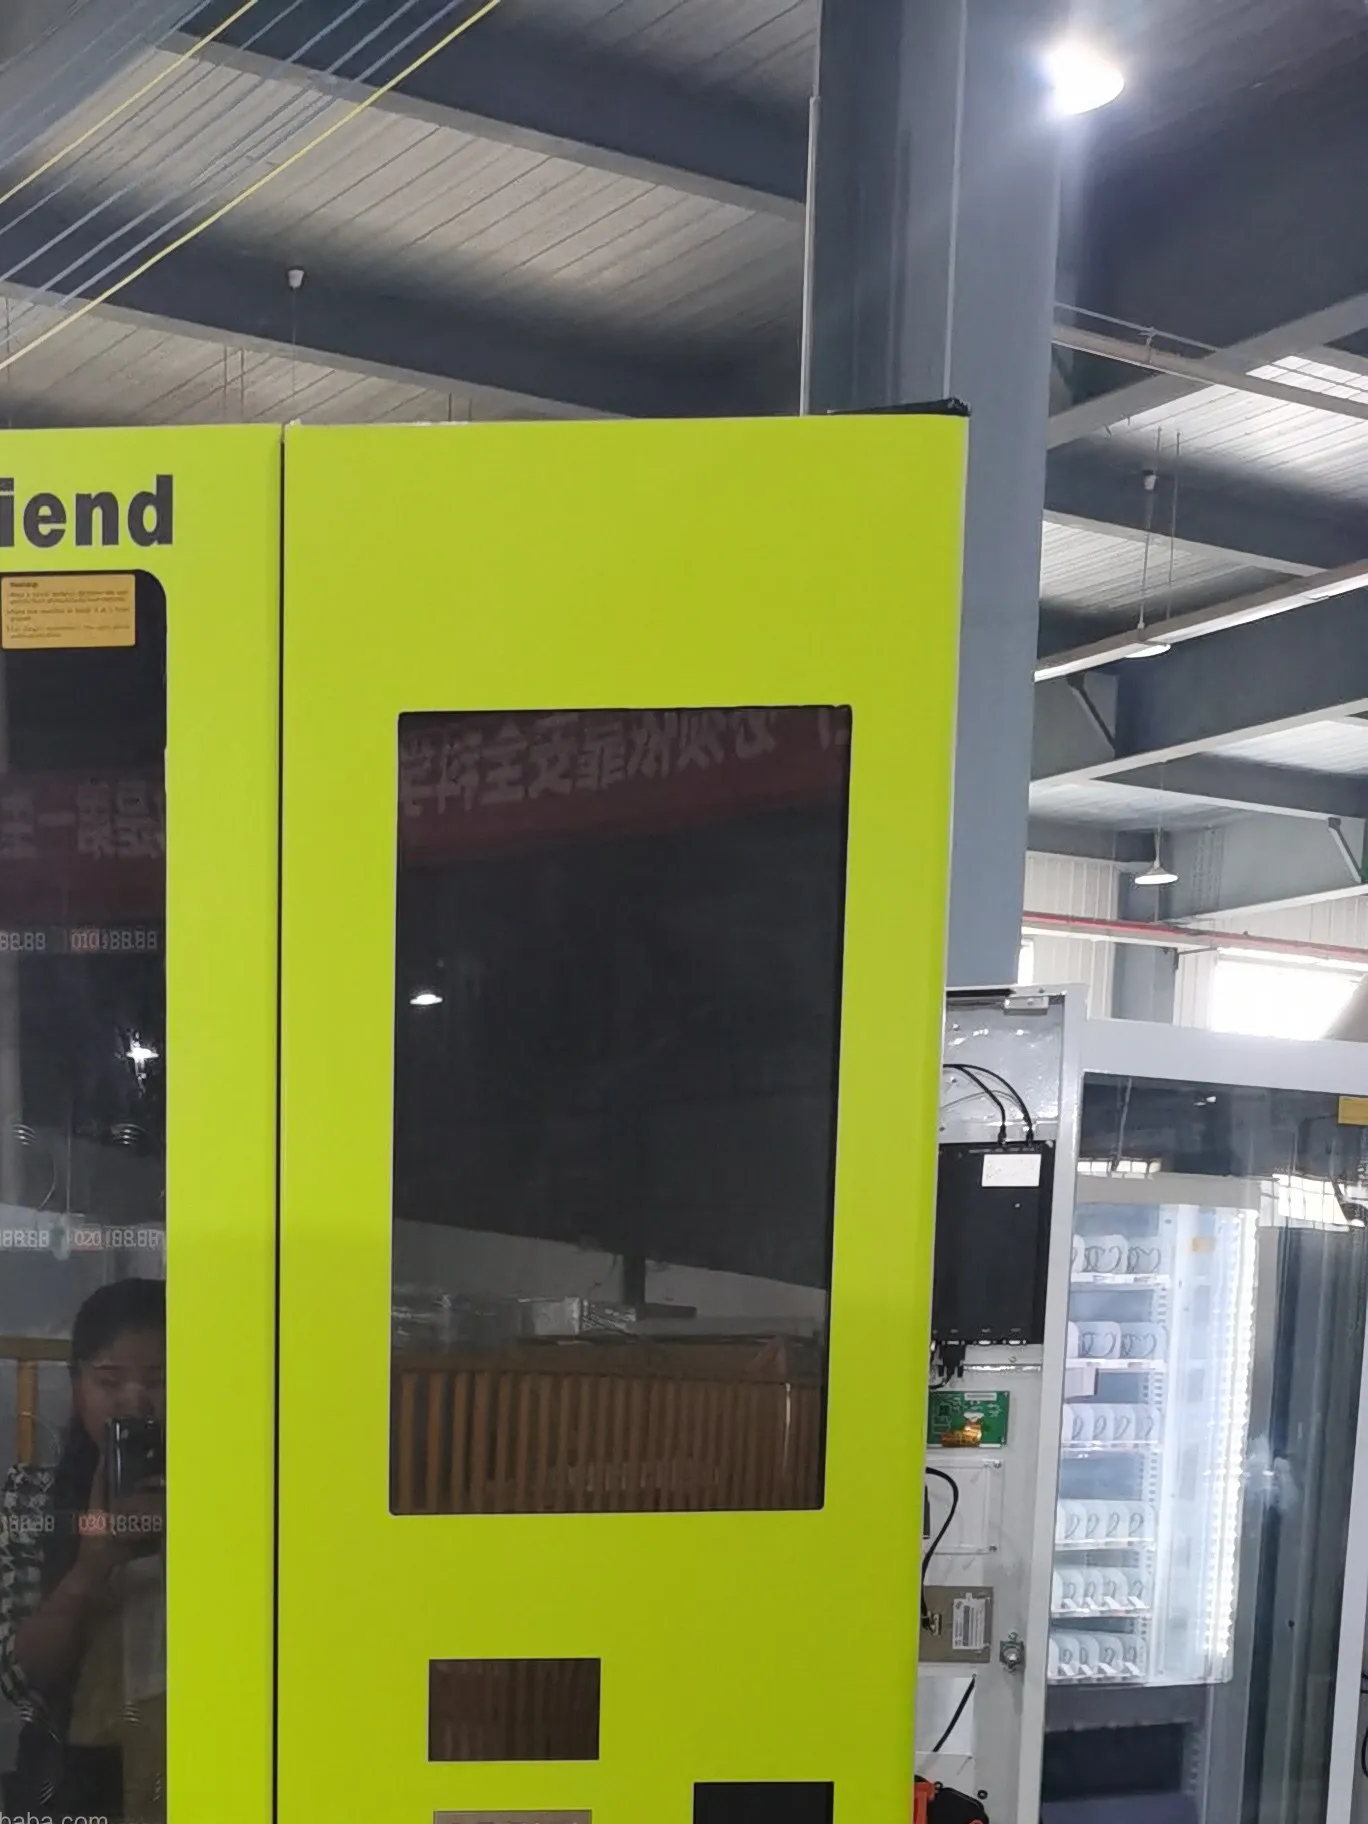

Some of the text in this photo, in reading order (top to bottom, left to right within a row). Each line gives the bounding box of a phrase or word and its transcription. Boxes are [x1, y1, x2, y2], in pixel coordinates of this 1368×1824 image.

[71, 931, 100, 949] 010
[73, 1230, 101, 1247] 020
[78, 1514, 106, 1532] 030
